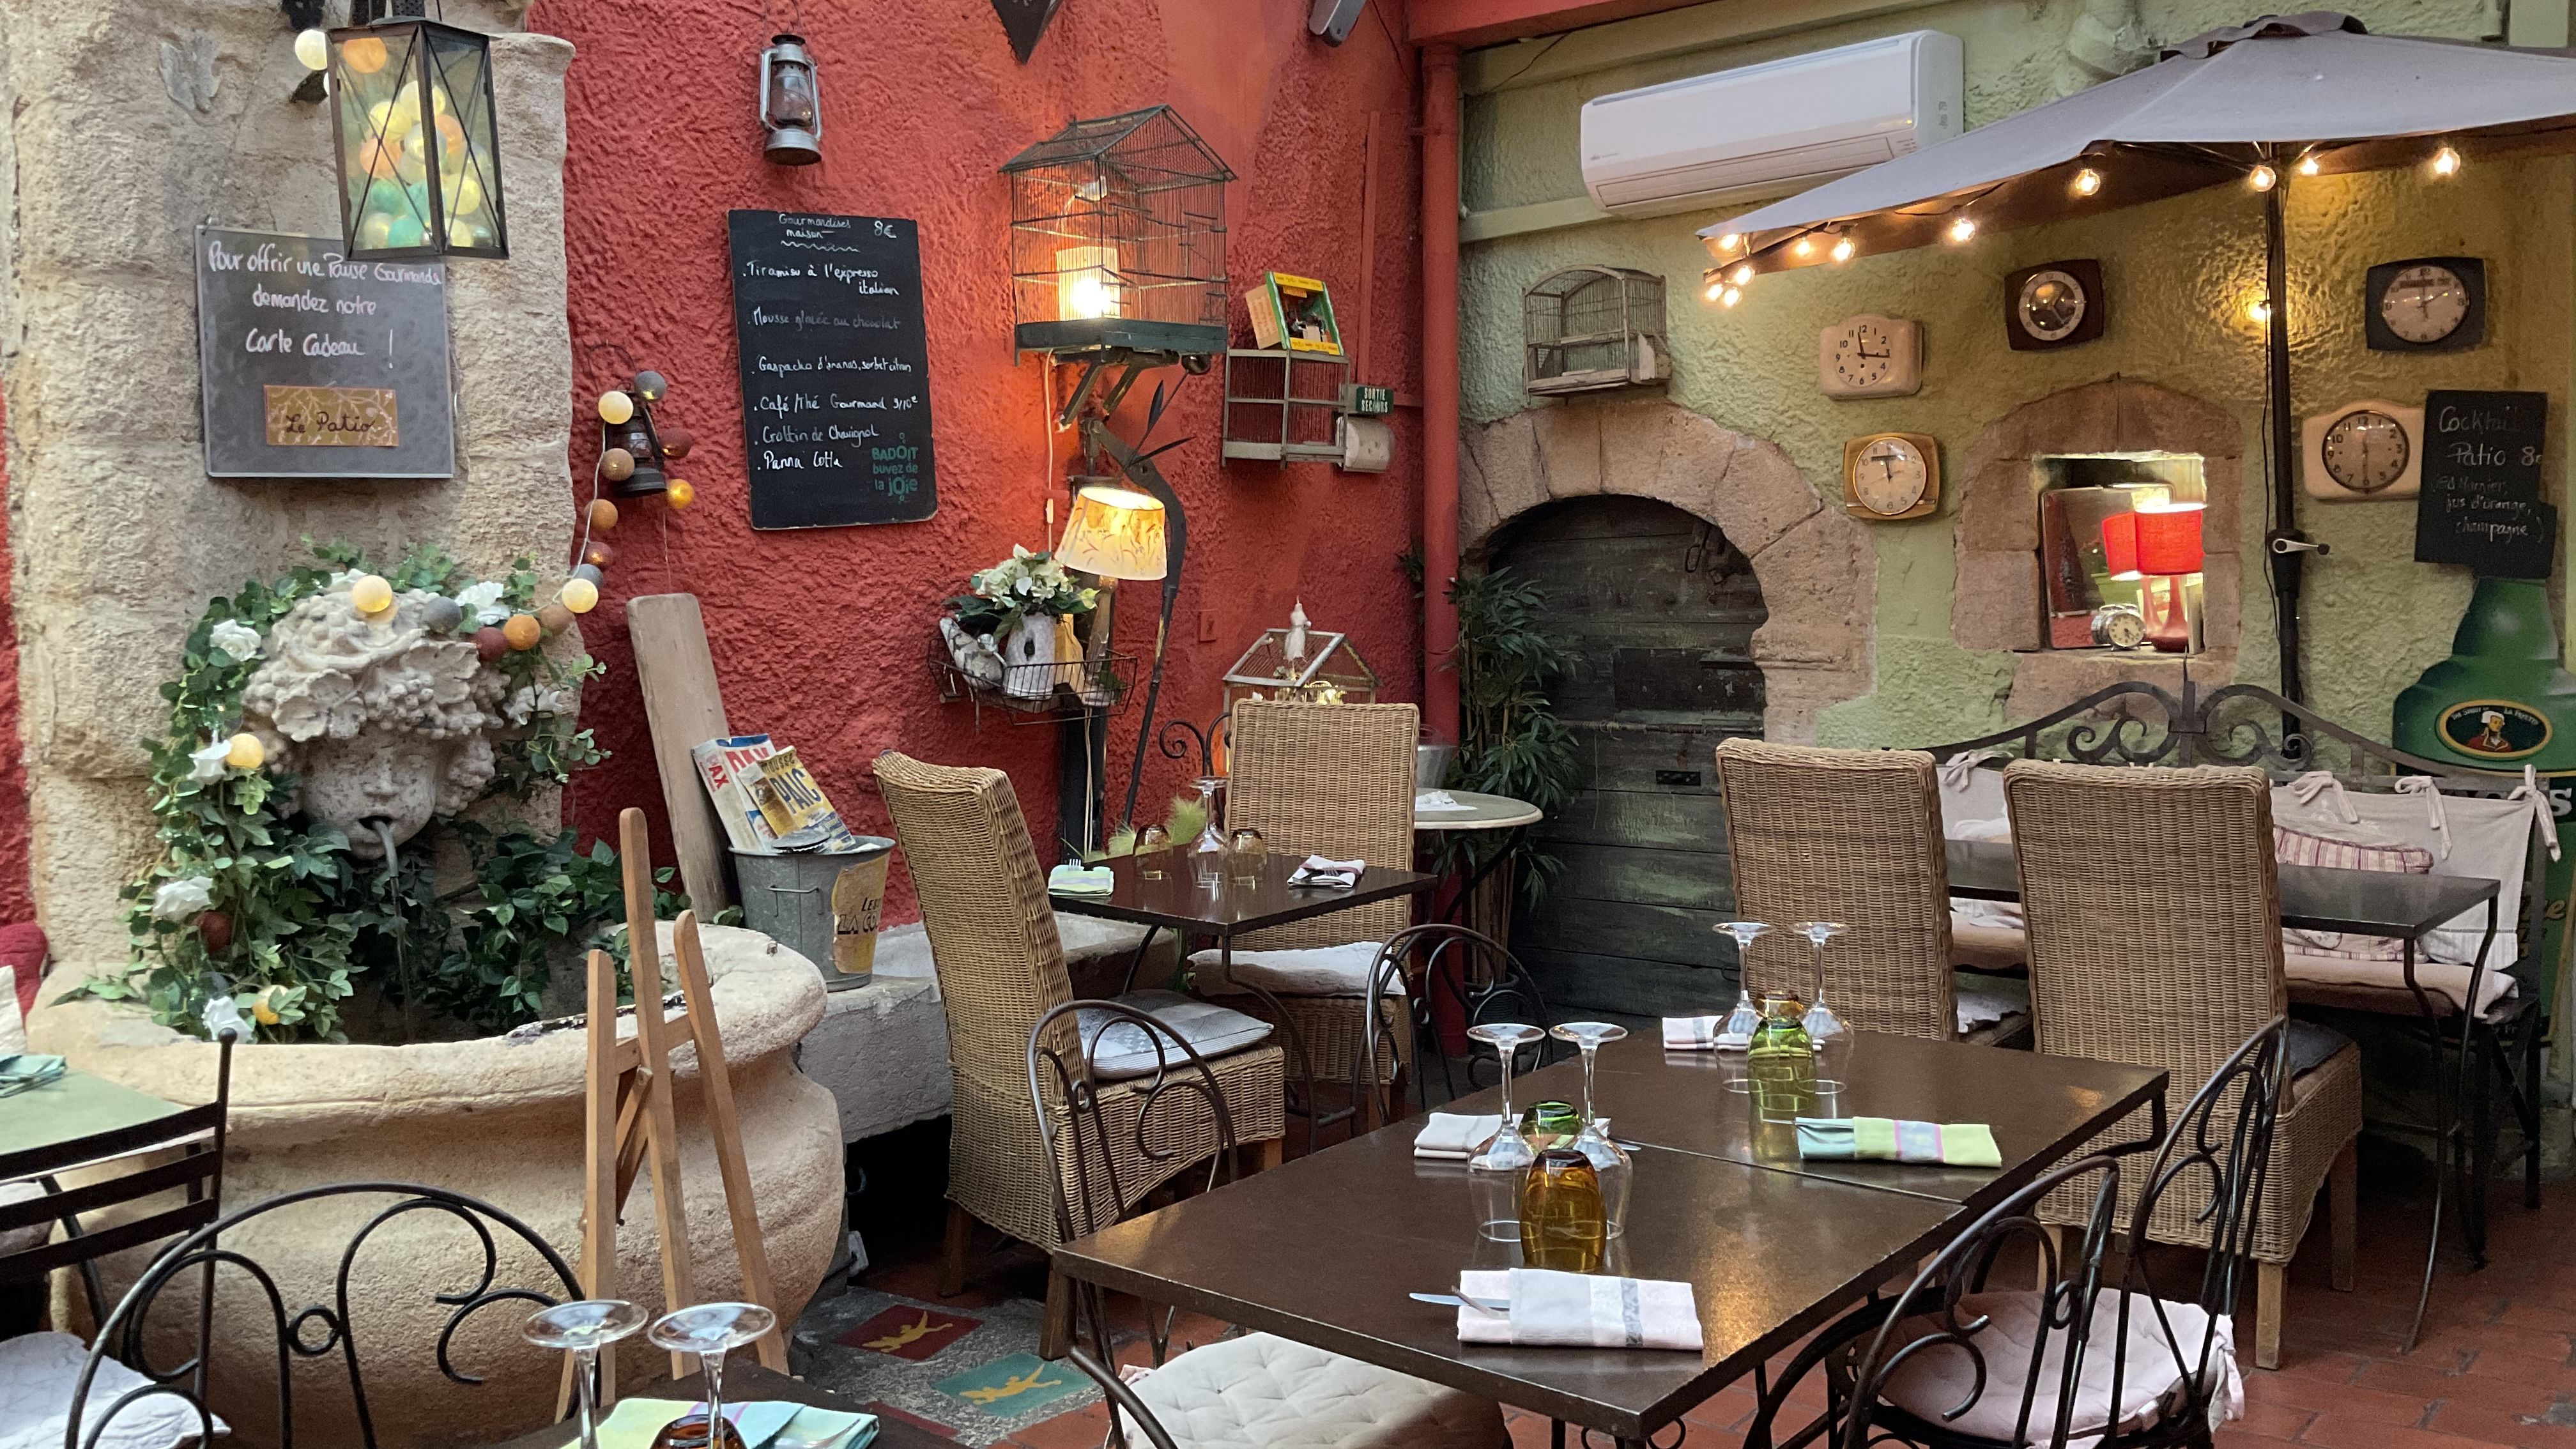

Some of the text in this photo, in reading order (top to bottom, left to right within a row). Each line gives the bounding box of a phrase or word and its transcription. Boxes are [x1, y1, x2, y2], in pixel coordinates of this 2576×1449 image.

[209, 241, 241, 272] Pour
[247, 243, 293, 273] offrir
[297, 261, 325, 277] une
[324, 253, 367, 280] Pause
[747, 259, 800, 277] Tiramisu
[808, 264, 817, 277] à
[253, 283, 376, 316] demandez notre
[754, 306, 790, 325] Mousse
[1848, 330, 1854, 338] 11
[1859, 325, 1868, 334] 12
[1873, 327, 1876, 335] 1
[246, 328, 394, 369] Carte Cadeau !
[1839, 340, 1848, 348] 10
[1881, 336, 1887, 345] 2
[1836, 353, 1841, 362] 9
[759, 356, 813, 378] Gaspacho
[1880, 362, 1885, 371] 4
[1871, 372, 1877, 381] 5
[1364, 387, 1386, 401] SORTIE
[760, 394, 789, 419] Café
[286, 411, 376, 434] Le Patio
[764, 450, 843, 470] Panna Cotta
[871, 445, 919, 461] BADOIT
[2448, 442, 2506, 466] Patio
[873, 463, 919, 475] buvez de
[874, 480, 885, 491] la
[2446, 494, 2465, 513] jus
[769, 767, 822, 815] PAIC
